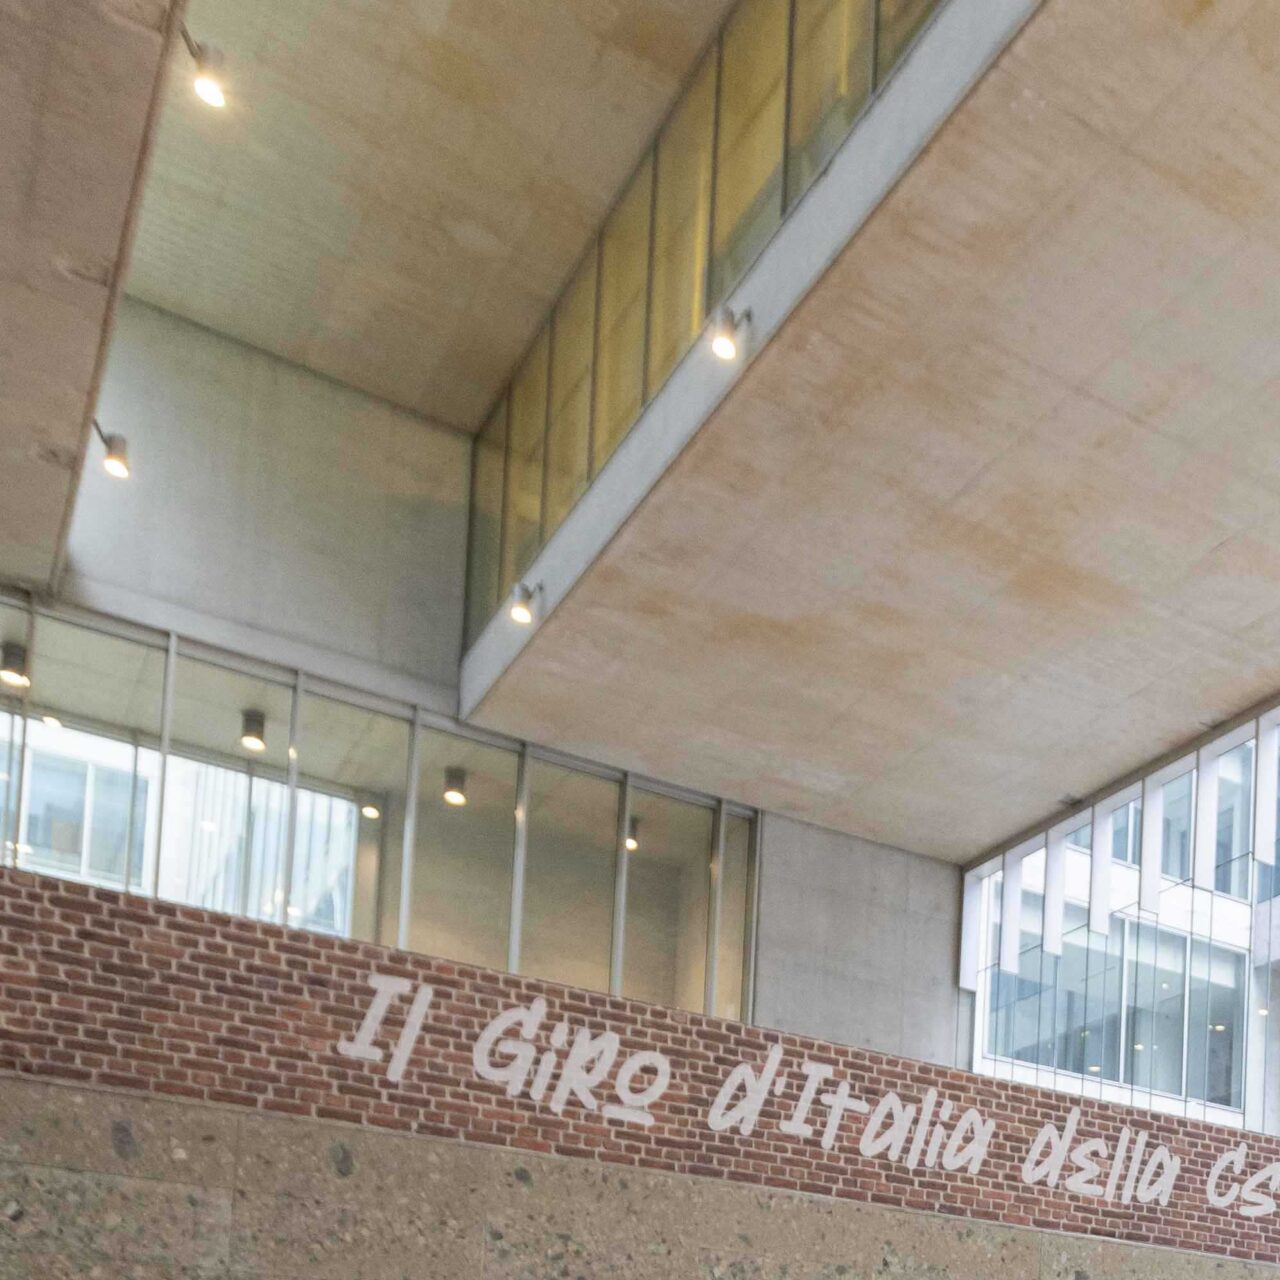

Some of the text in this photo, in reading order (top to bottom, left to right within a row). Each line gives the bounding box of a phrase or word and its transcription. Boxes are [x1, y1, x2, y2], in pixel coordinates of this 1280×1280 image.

[336, 973, 432, 1082] Il
[707, 1043, 995, 1176] d'Italia
[1022, 1106, 1180, 1207] della
